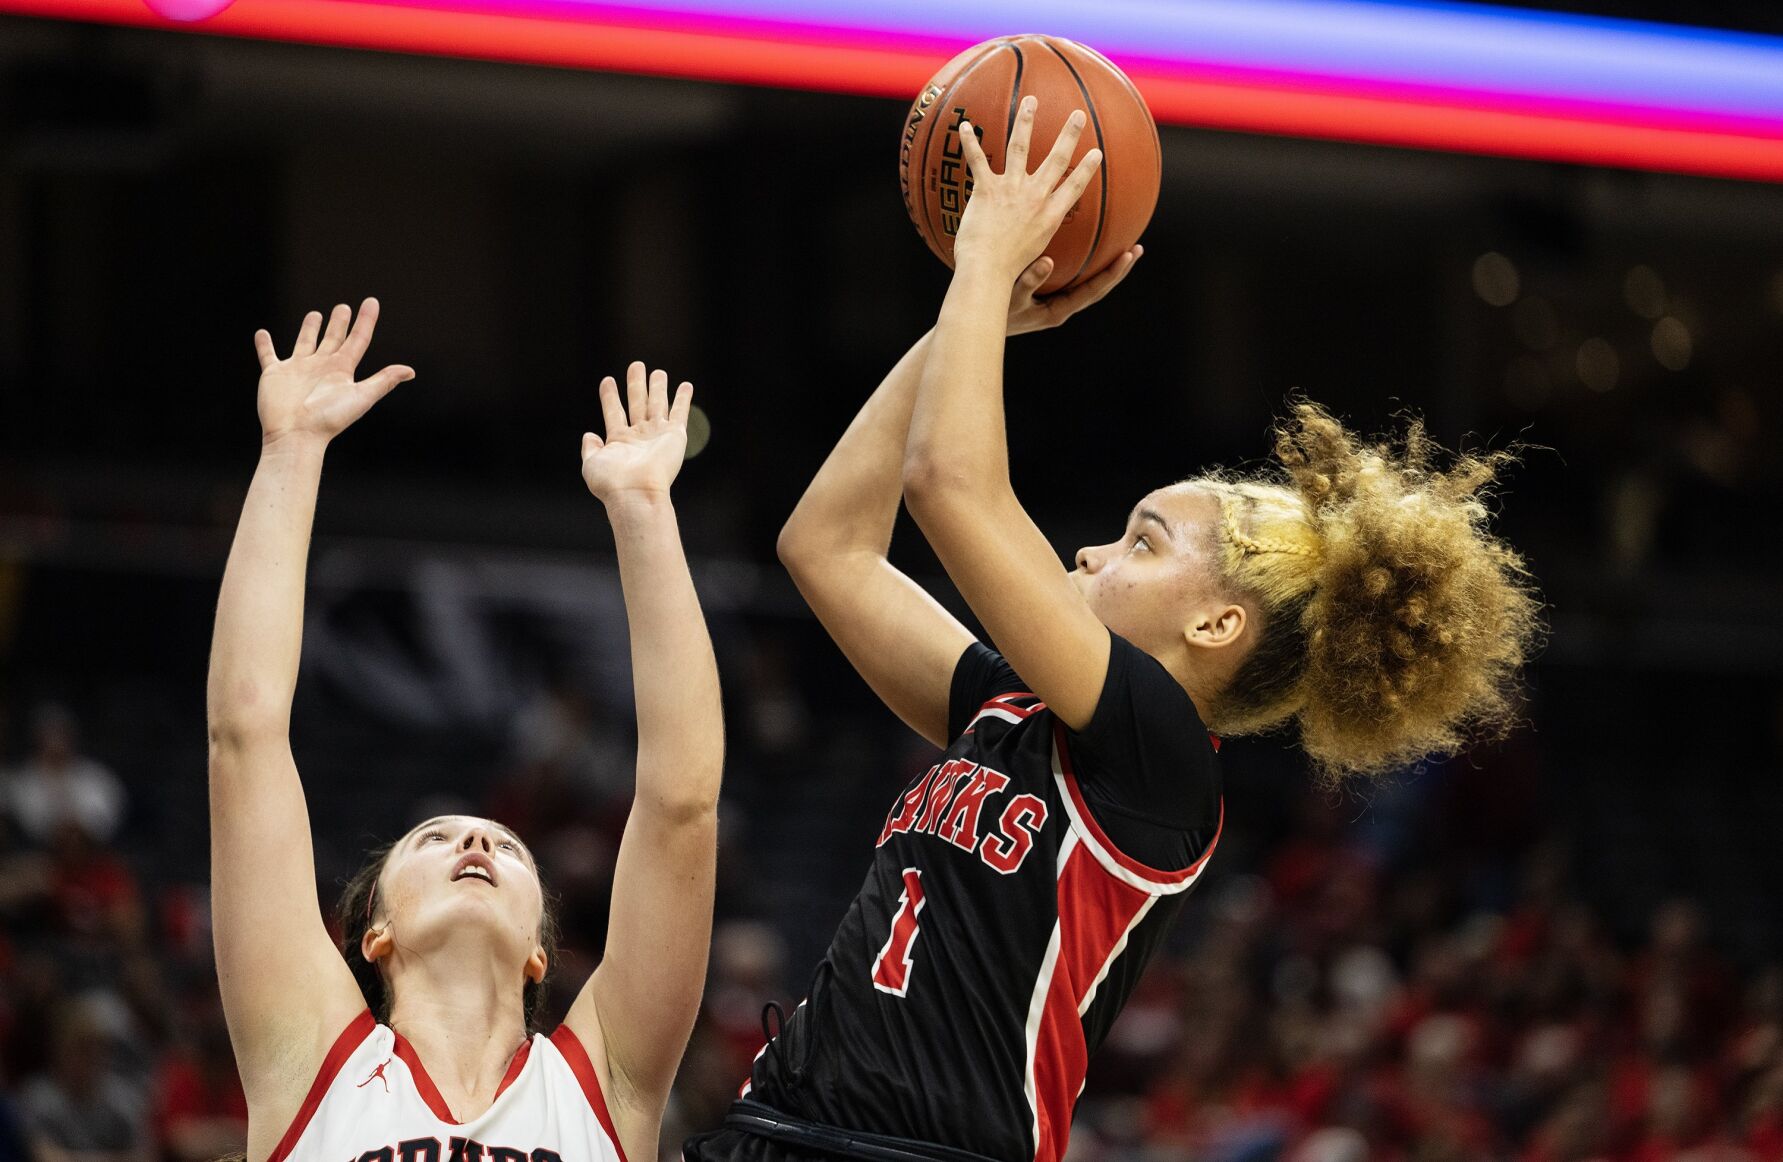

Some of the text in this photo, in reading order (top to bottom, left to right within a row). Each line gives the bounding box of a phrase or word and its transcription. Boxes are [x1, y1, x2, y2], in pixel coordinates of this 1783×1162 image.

[940, 107, 970, 237] EGACY
[876, 758, 1048, 875] AWKS
[871, 867, 926, 998] 1
